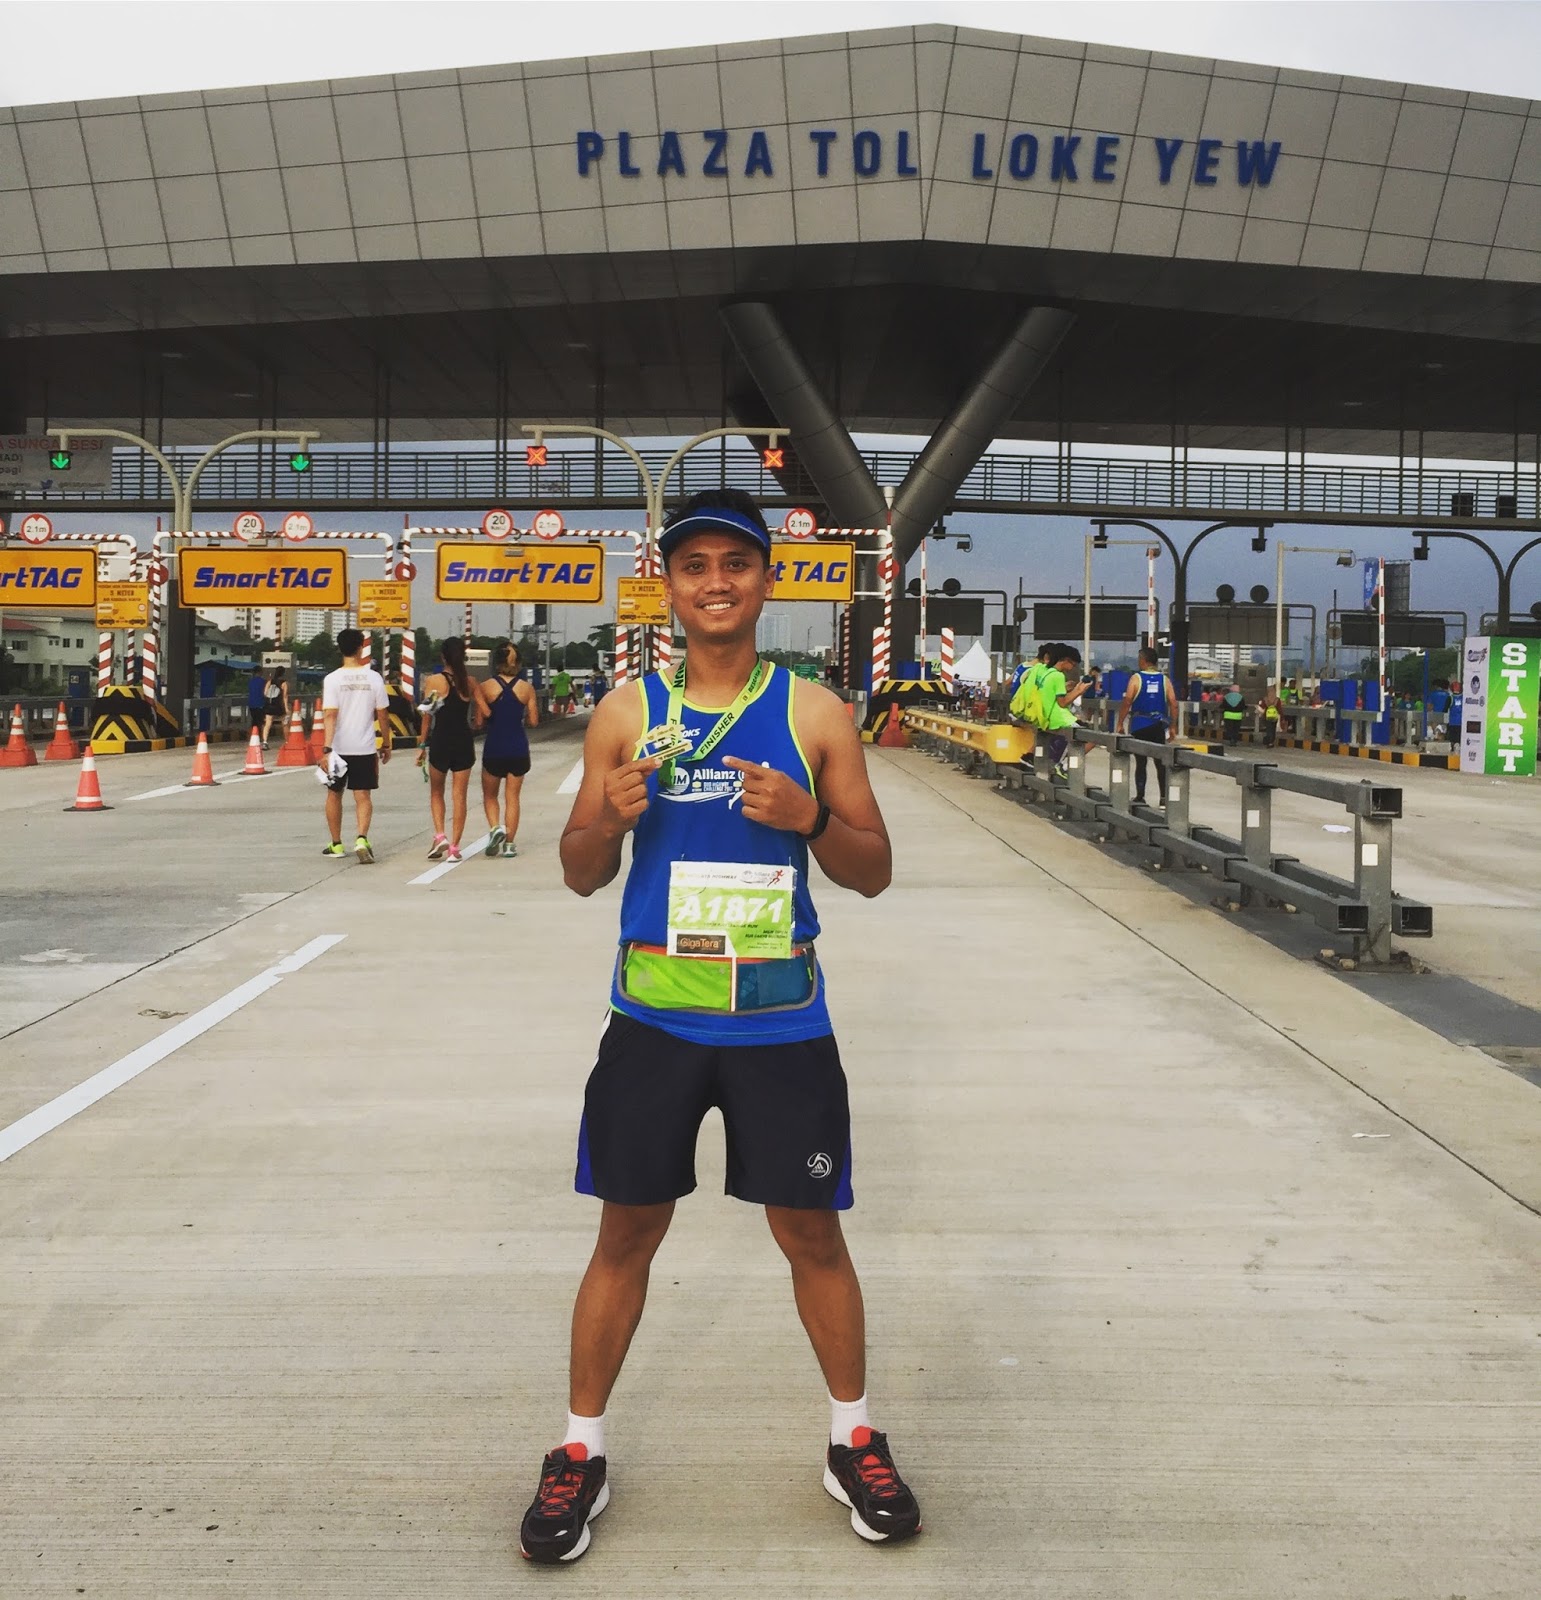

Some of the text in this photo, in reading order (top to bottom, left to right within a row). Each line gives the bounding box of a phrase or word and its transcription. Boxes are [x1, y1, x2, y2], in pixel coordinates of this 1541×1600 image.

[576, 130, 1282, 187] PLAZA TOL LOKE YEW
[8, 439, 62, 450] SUNGA
[243, 518, 257, 528] 20
[492, 515, 506, 525] 20
[790, 519, 810, 528] 2.1m
[26, 525, 47, 533] 2.1m
[0, 567, 83, 588] rtTAG
[193, 567, 333, 588] SmartTAG
[1497, 642, 1528, 772] START
[682, 728, 701, 738] OKS
[699, 712, 735, 755] FINISHER
[692, 768, 736, 780] Allianz
[674, 894, 785, 925] A1871
[680, 937, 719, 949] GigaTera
